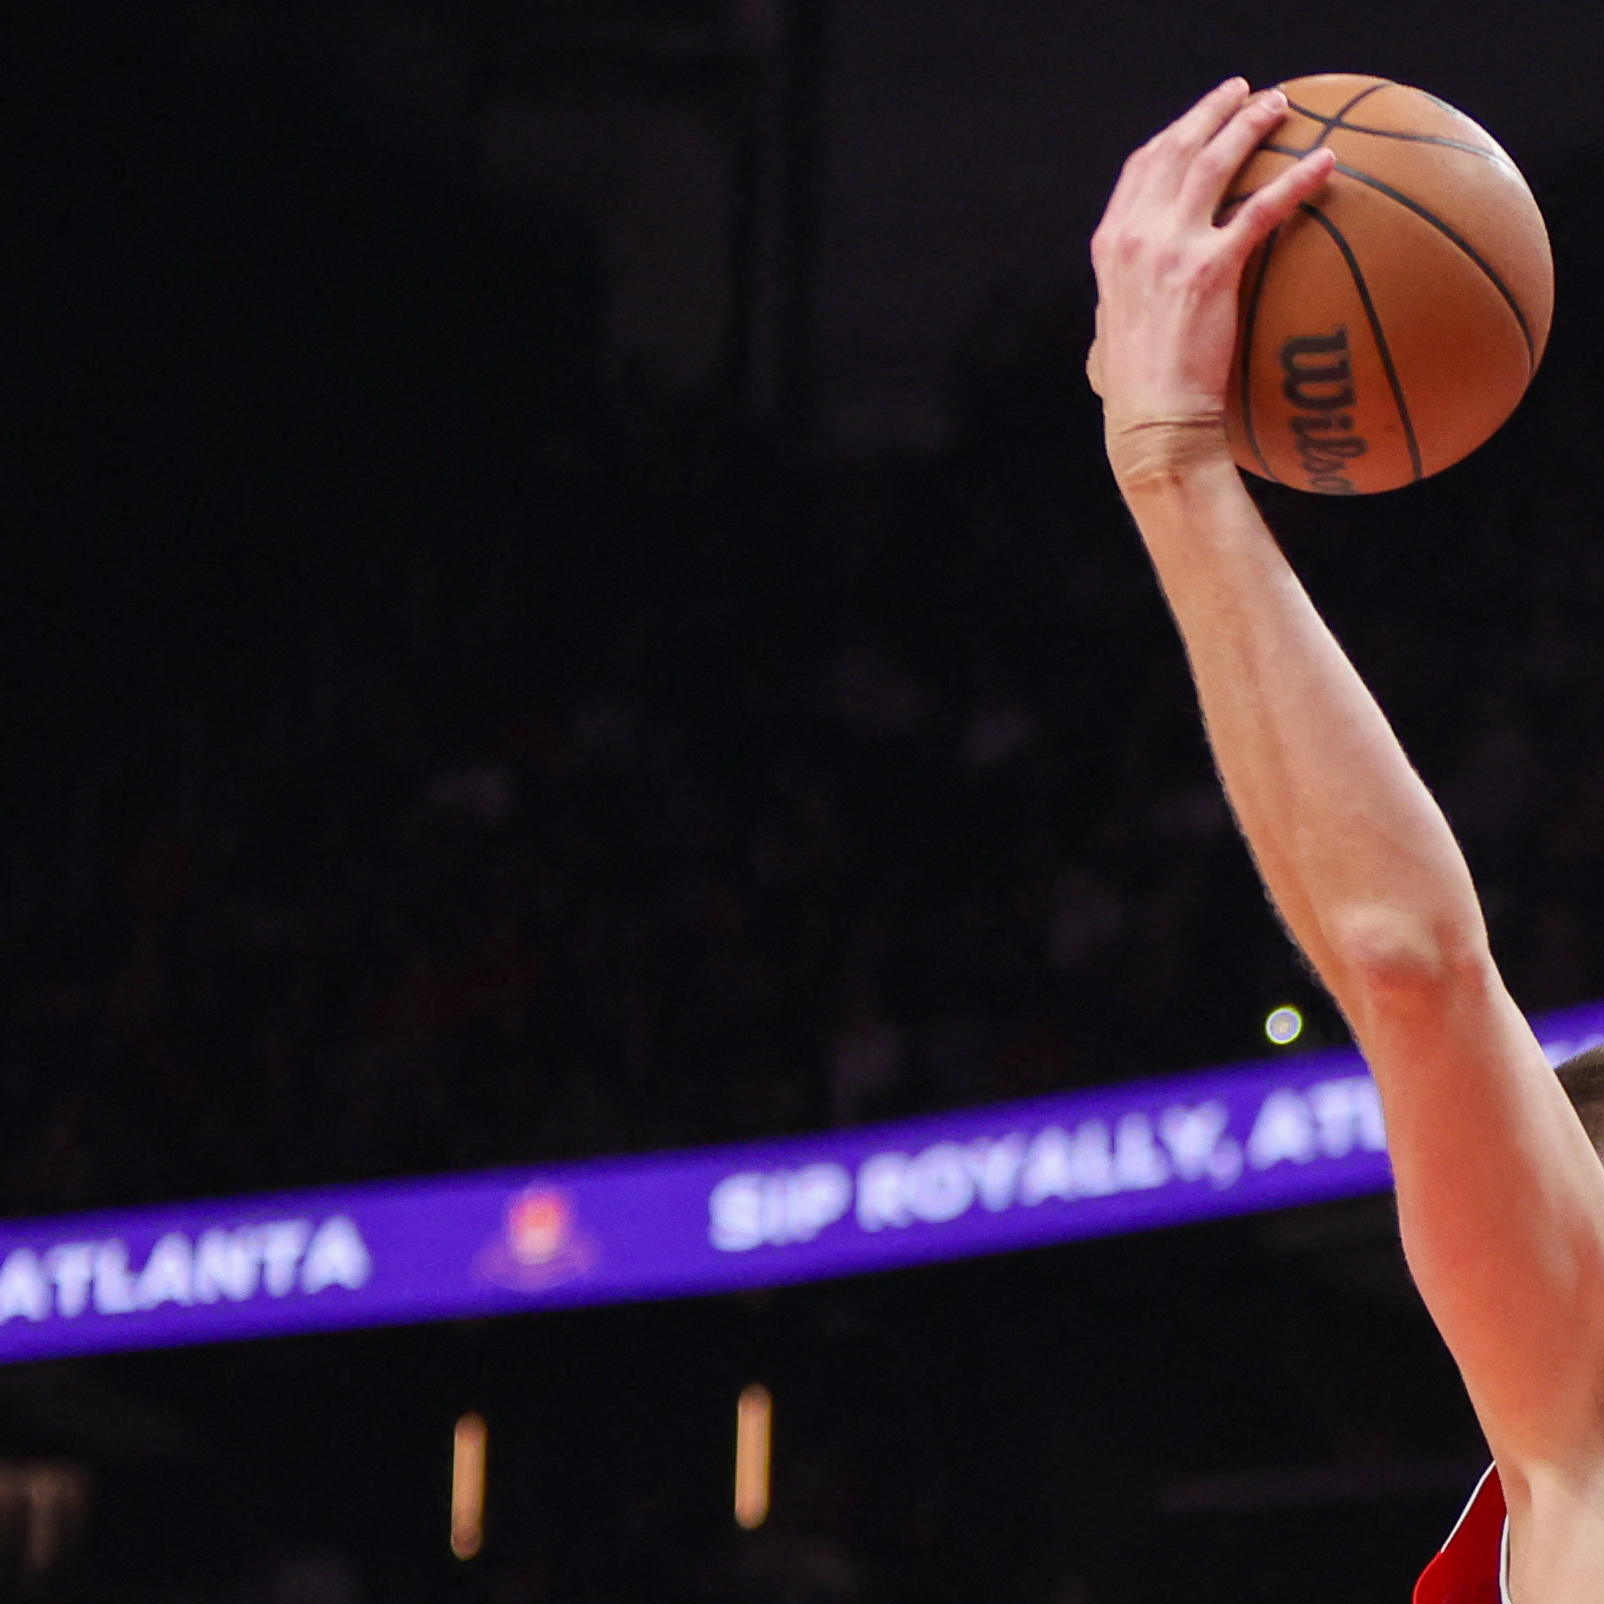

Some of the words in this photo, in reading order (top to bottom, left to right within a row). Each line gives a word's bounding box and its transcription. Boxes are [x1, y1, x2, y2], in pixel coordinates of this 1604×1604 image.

[709, 1163, 852, 1252] SIP
[855, 1102, 1244, 1233] ROYALLY,
[0, 1215, 370, 1326] ATLANTA
